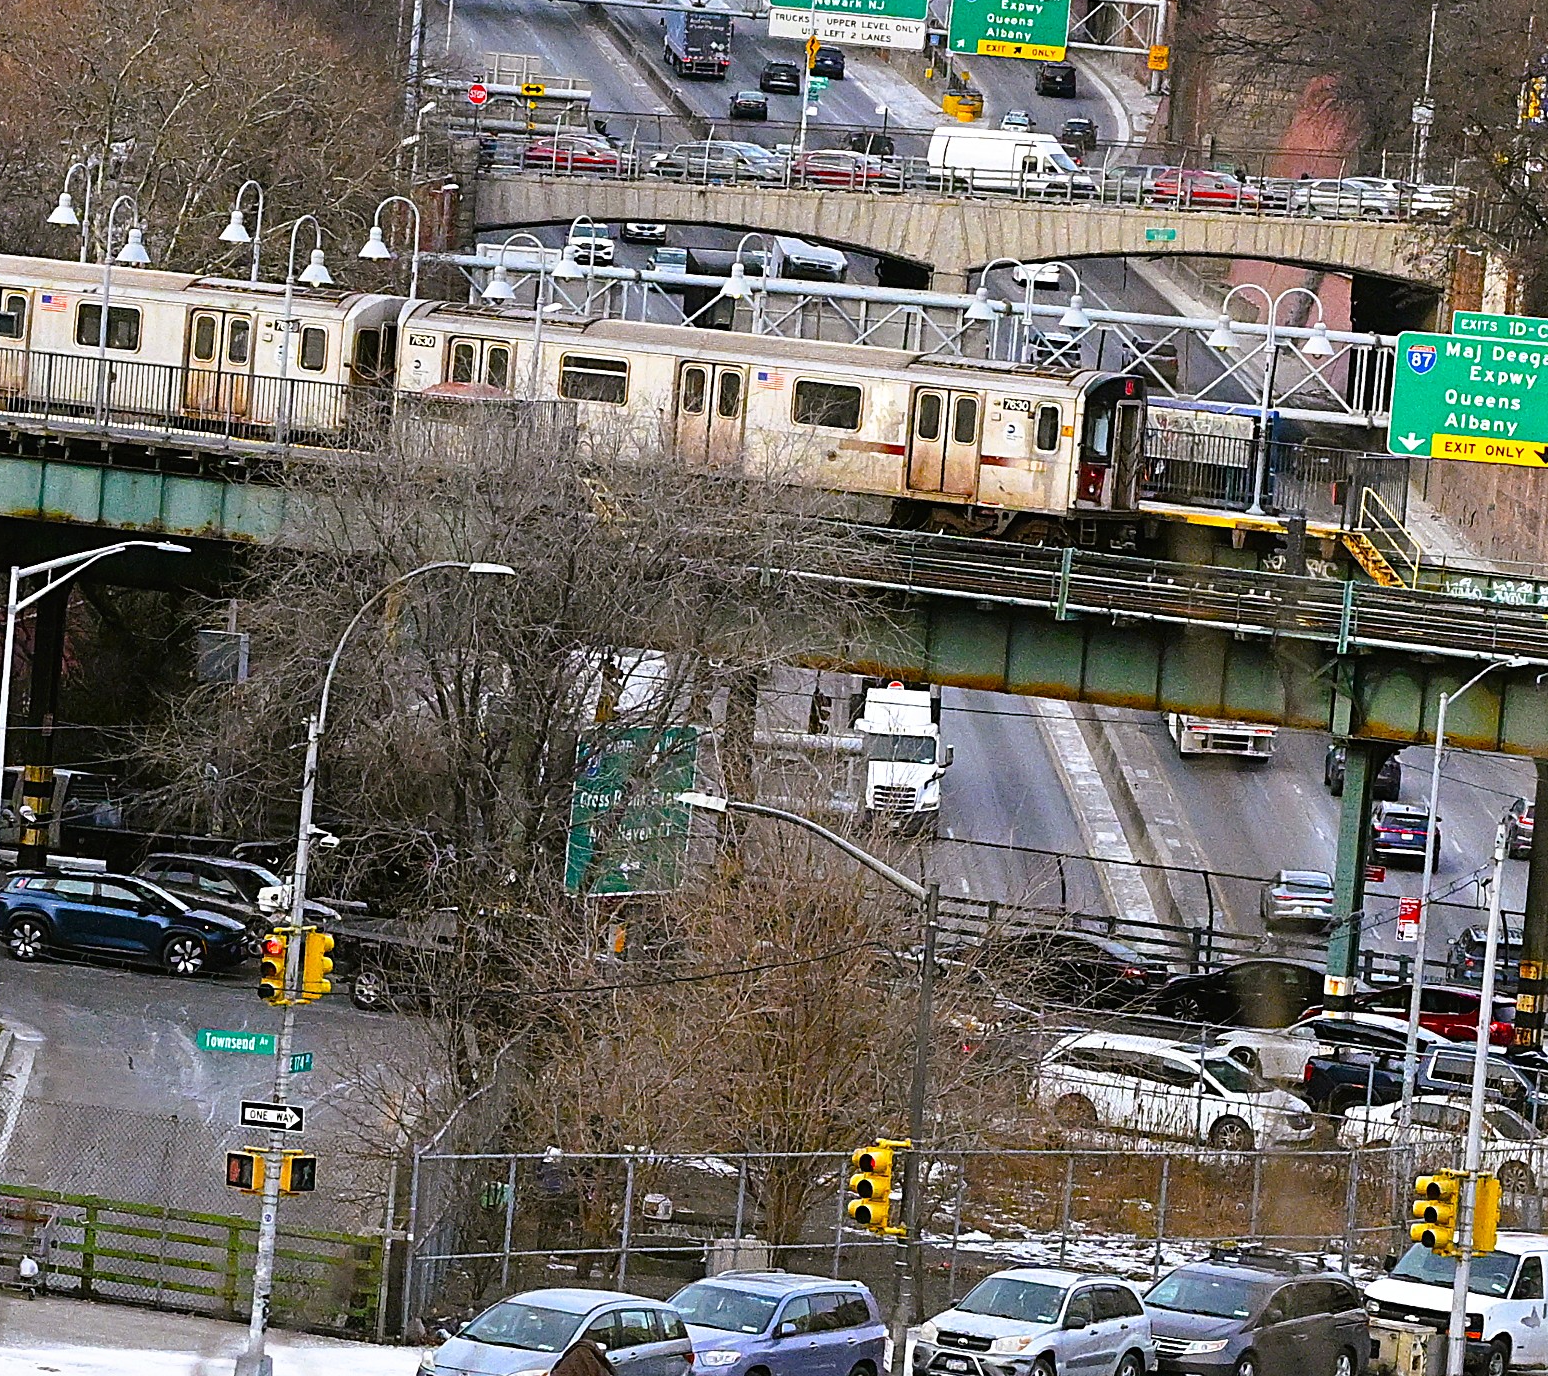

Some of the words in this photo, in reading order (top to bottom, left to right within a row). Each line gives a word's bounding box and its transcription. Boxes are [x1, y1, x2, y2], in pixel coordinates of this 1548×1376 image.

[868, 0, 885, 10] NJ
[1001, 0, 1043, 14] Expwy
[775, 13, 810, 23] TRUCKS
[827, 18, 856, 28] UPPER
[862, 21, 890, 31] LEVEL
[896, 24, 921, 34] ONLY
[986, 13, 1034, 26] Queens
[824, 30, 845, 39] LEFT
[861, 33, 892, 43] LANES
[986, 27, 1032, 42] Albany
[986, 44, 1006, 53] EXIT
[1031, 48, 1056, 57] ONLY
[1461, 318, 1498, 332] EXITS
[410, 335, 435, 346] 7630
[1411, 352, 1433, 368] 87
[1445, 341, 1482, 363] Maj
[1469, 365, 1537, 389] Expwy
[1005, 399, 1029, 410] 7630
[1445, 389, 1521, 410] Queens
[1444, 412, 1518, 436] Albany
[1445, 441, 1476, 454] EXIT
[1485, 445, 1525, 459] ONLY
[205, 1032, 255, 1051] Townsend
[259, 1036, 269, 1045] Av
[294, 1056, 305, 1071] 174
[250, 1109, 268, 1121] ONE
[276, 1111, 295, 1123] WAY
